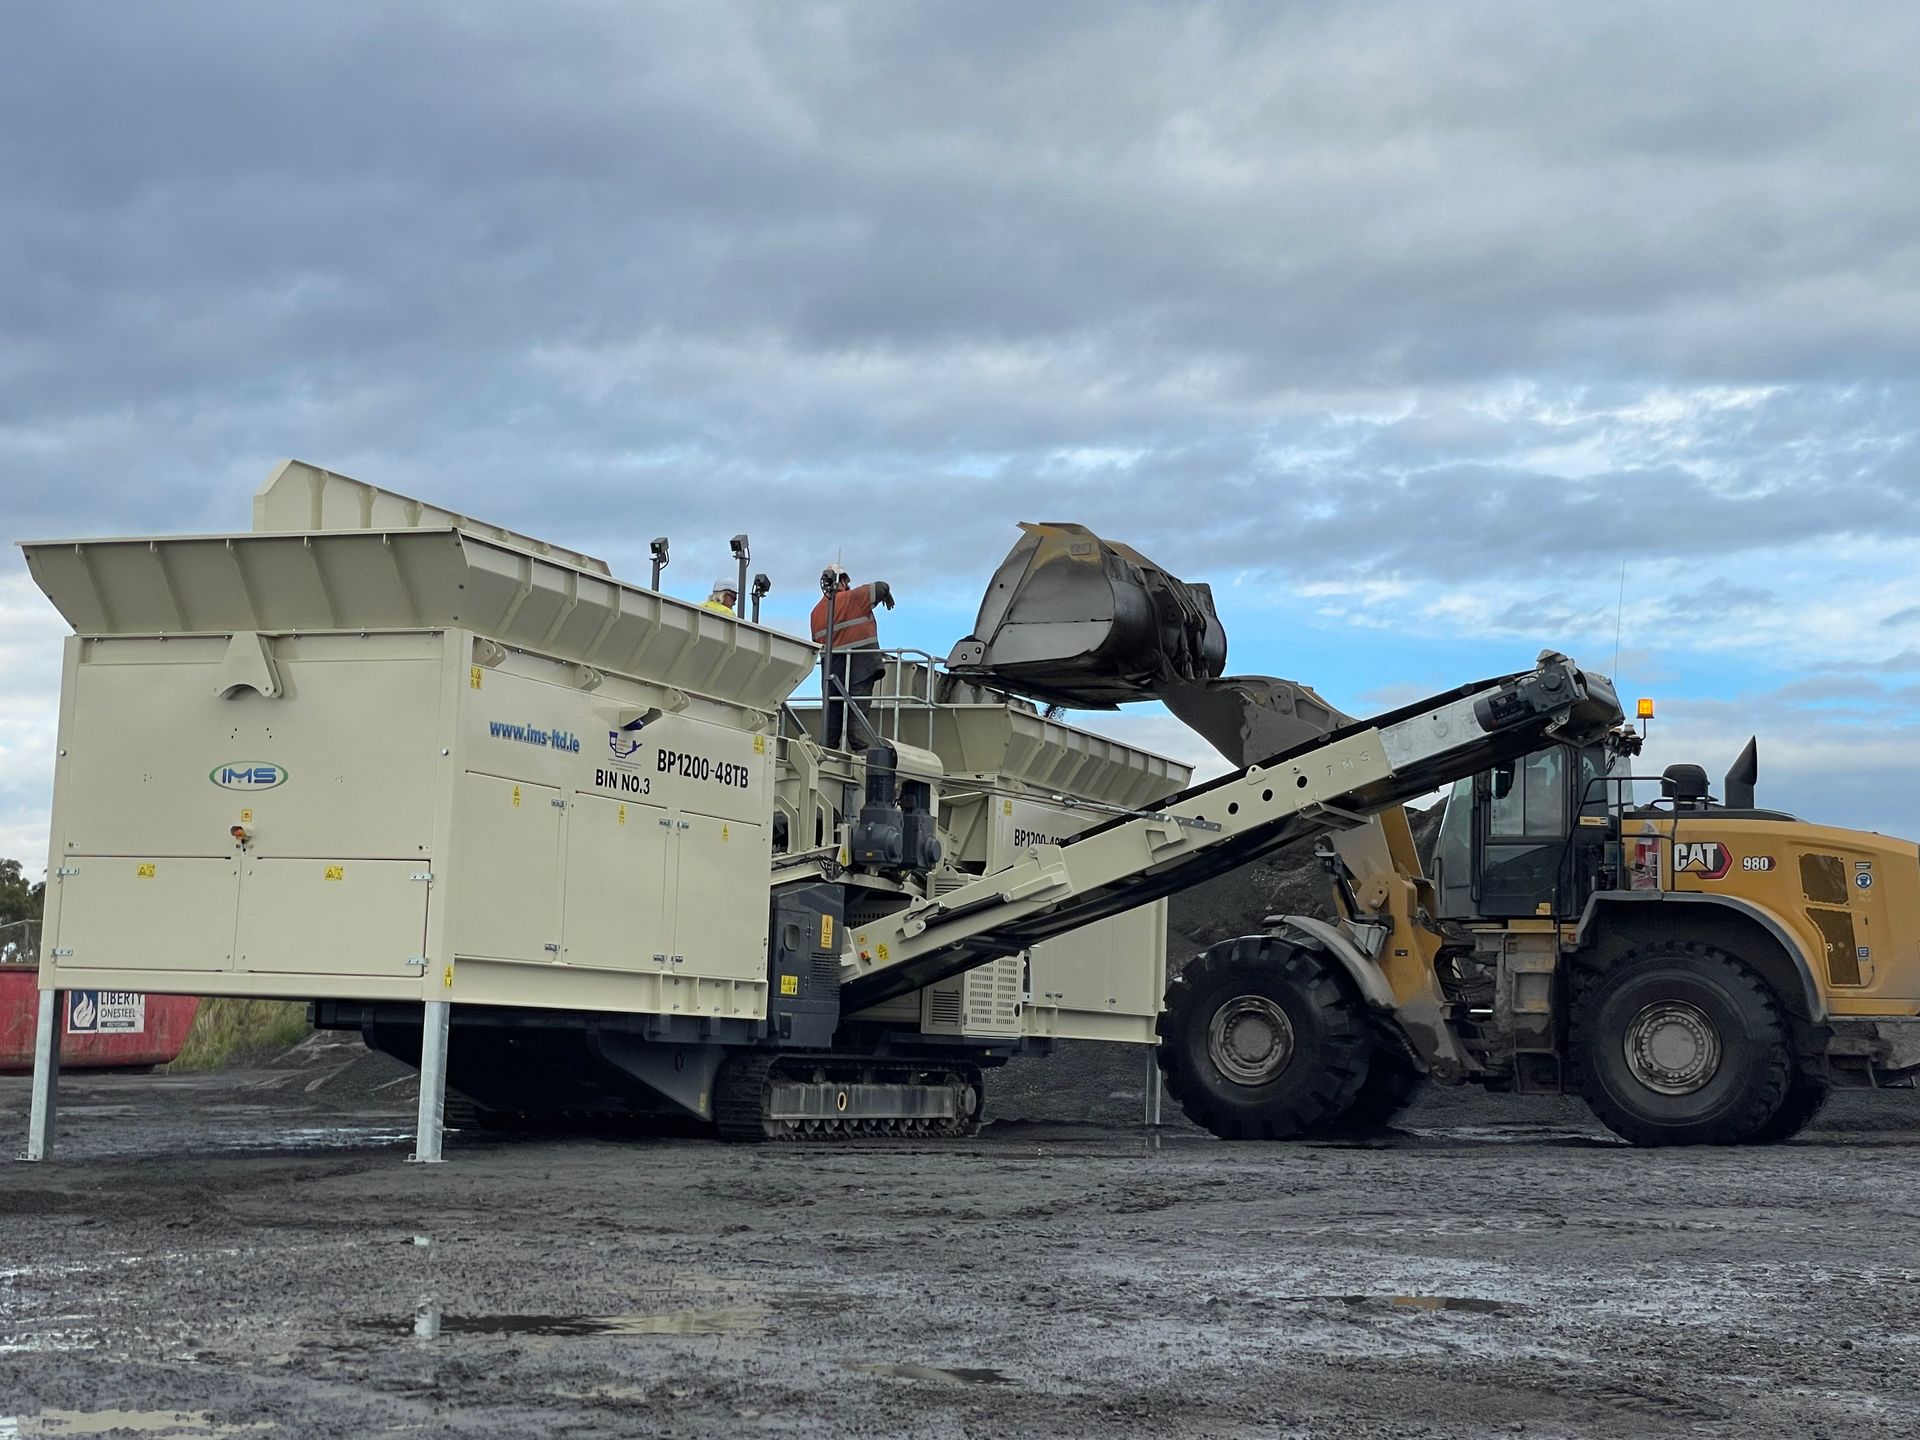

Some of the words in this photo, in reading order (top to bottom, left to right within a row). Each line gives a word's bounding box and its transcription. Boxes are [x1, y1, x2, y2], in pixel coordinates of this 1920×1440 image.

[489, 721, 580, 754] www.ims-ltd.ie
[222, 767, 277, 784] IMS
[657, 748, 749, 789] BP1200-48TB
[595, 768, 618, 789] BIN
[621, 773, 650, 795] NO.3
[1673, 843, 1718, 872] CAT
[1742, 856, 1769, 871] 980
[100, 991, 143, 1006] LIBERTY
[100, 1008, 136, 1018] ONESTEEL
